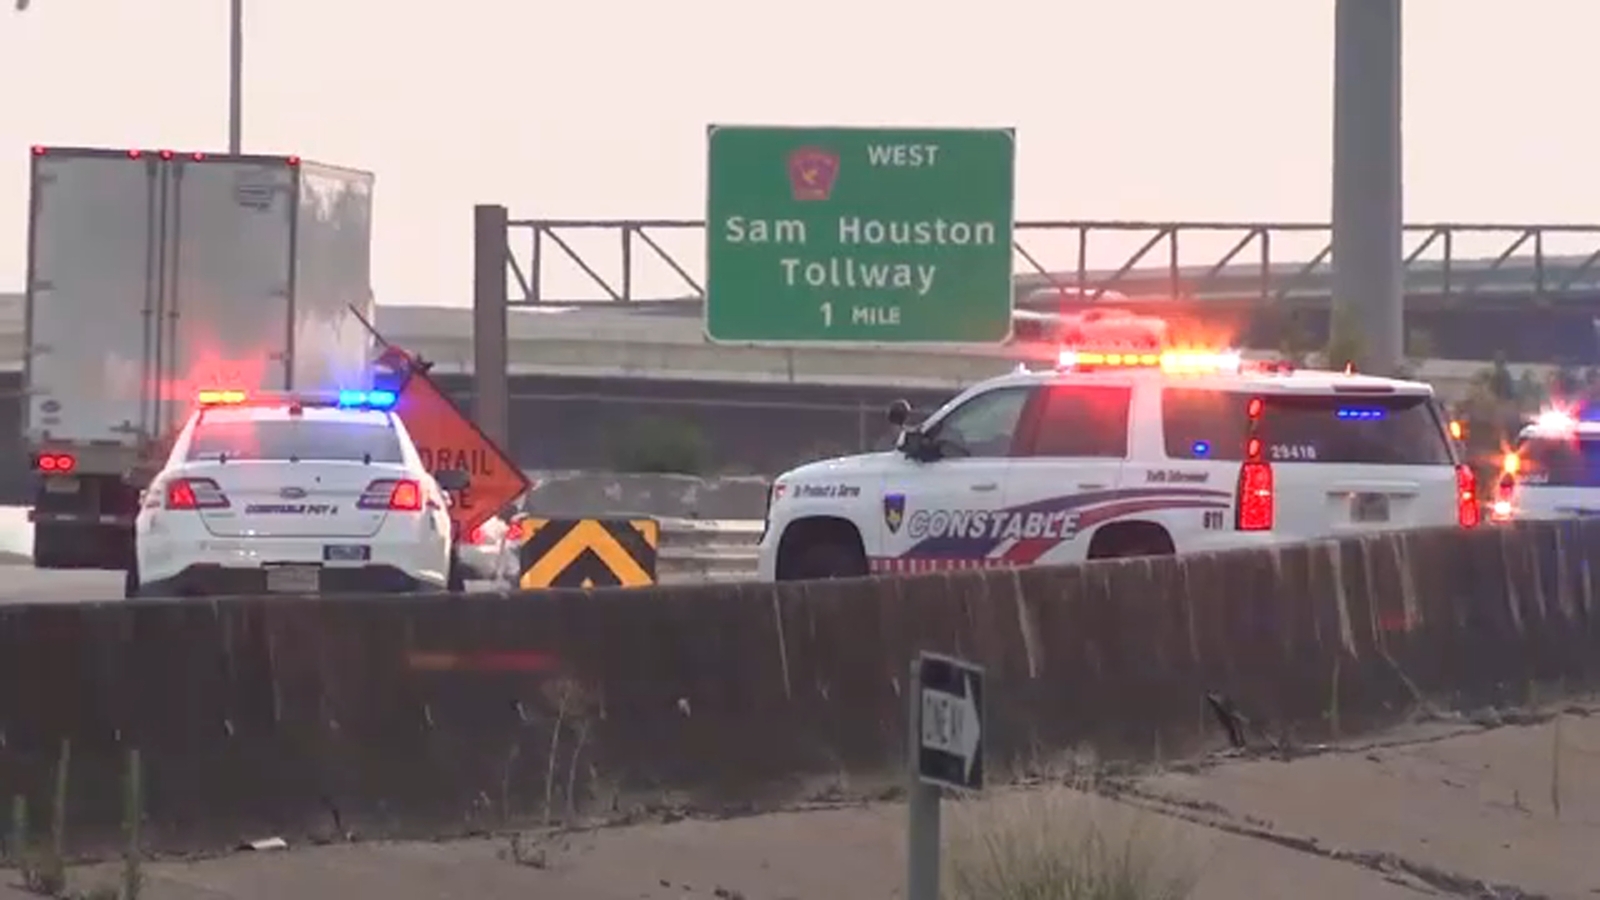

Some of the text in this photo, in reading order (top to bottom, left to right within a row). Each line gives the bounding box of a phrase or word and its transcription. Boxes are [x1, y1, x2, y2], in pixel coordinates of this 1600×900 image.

[867, 144, 938, 166] WEST
[725, 216, 995, 245] Sam Houston
[780, 258, 936, 295] Tollway
[820, 302, 901, 327] 1 MILE
[906, 508, 1082, 541] CONSTABLE
